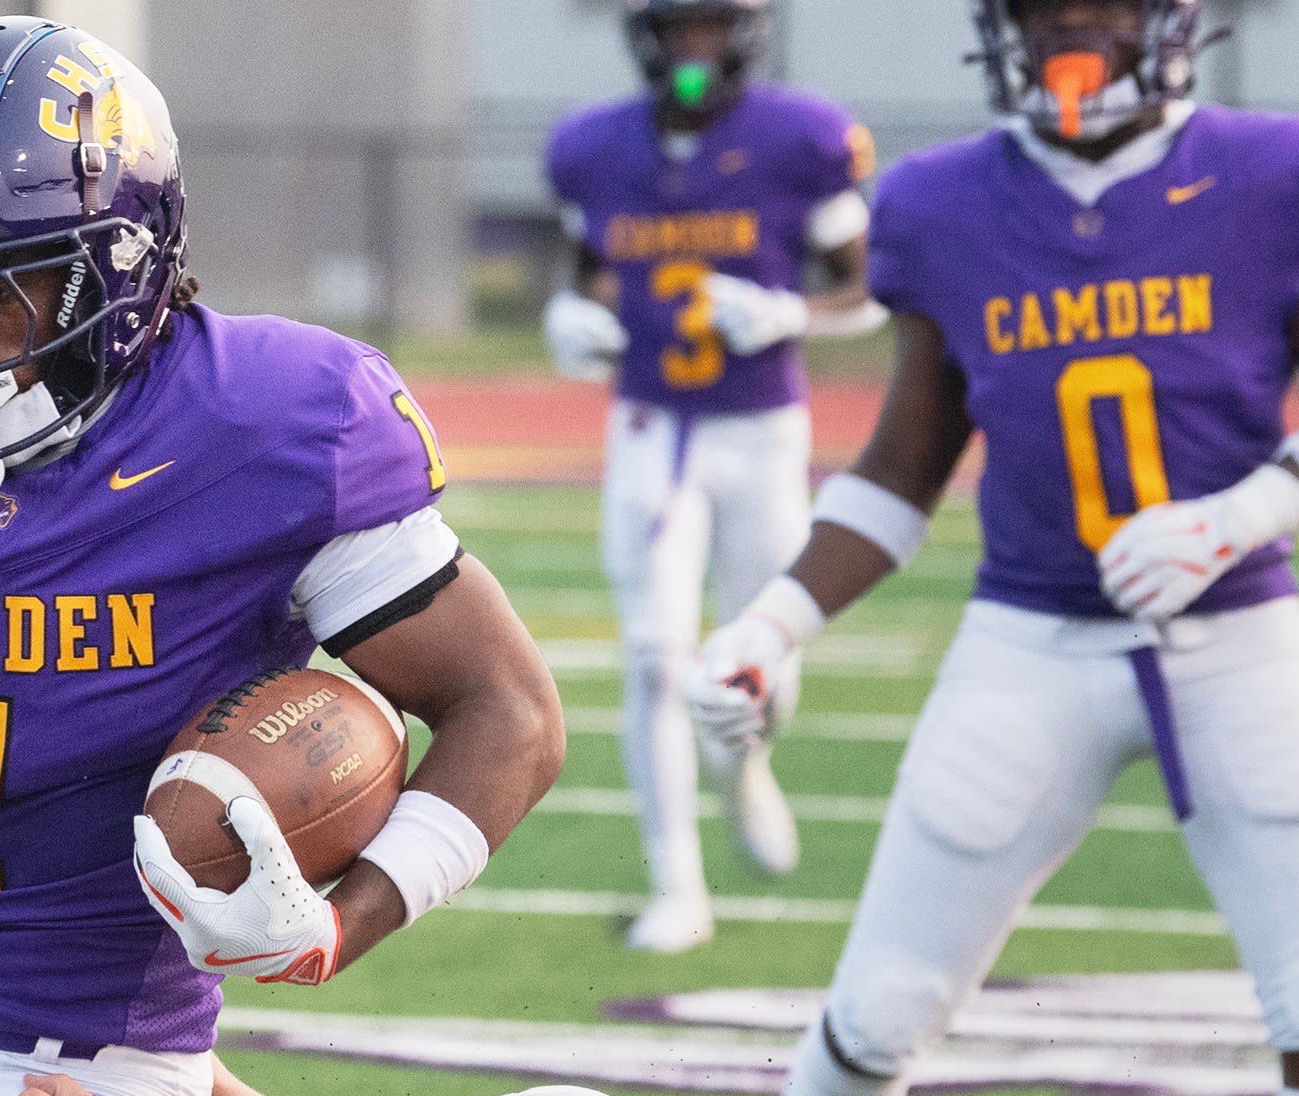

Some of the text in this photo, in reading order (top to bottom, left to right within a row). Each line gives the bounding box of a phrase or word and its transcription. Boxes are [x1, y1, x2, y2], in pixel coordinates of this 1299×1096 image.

[56, 261, 87, 329] Riddell
[651, 260, 726, 391] 3
[984, 274, 1214, 353] CAMDEN
[391, 389, 446, 496] 1
[1056, 354, 1171, 554] 0
[249, 686, 340, 744] Wilson
[330, 752, 364, 785] NCAA
